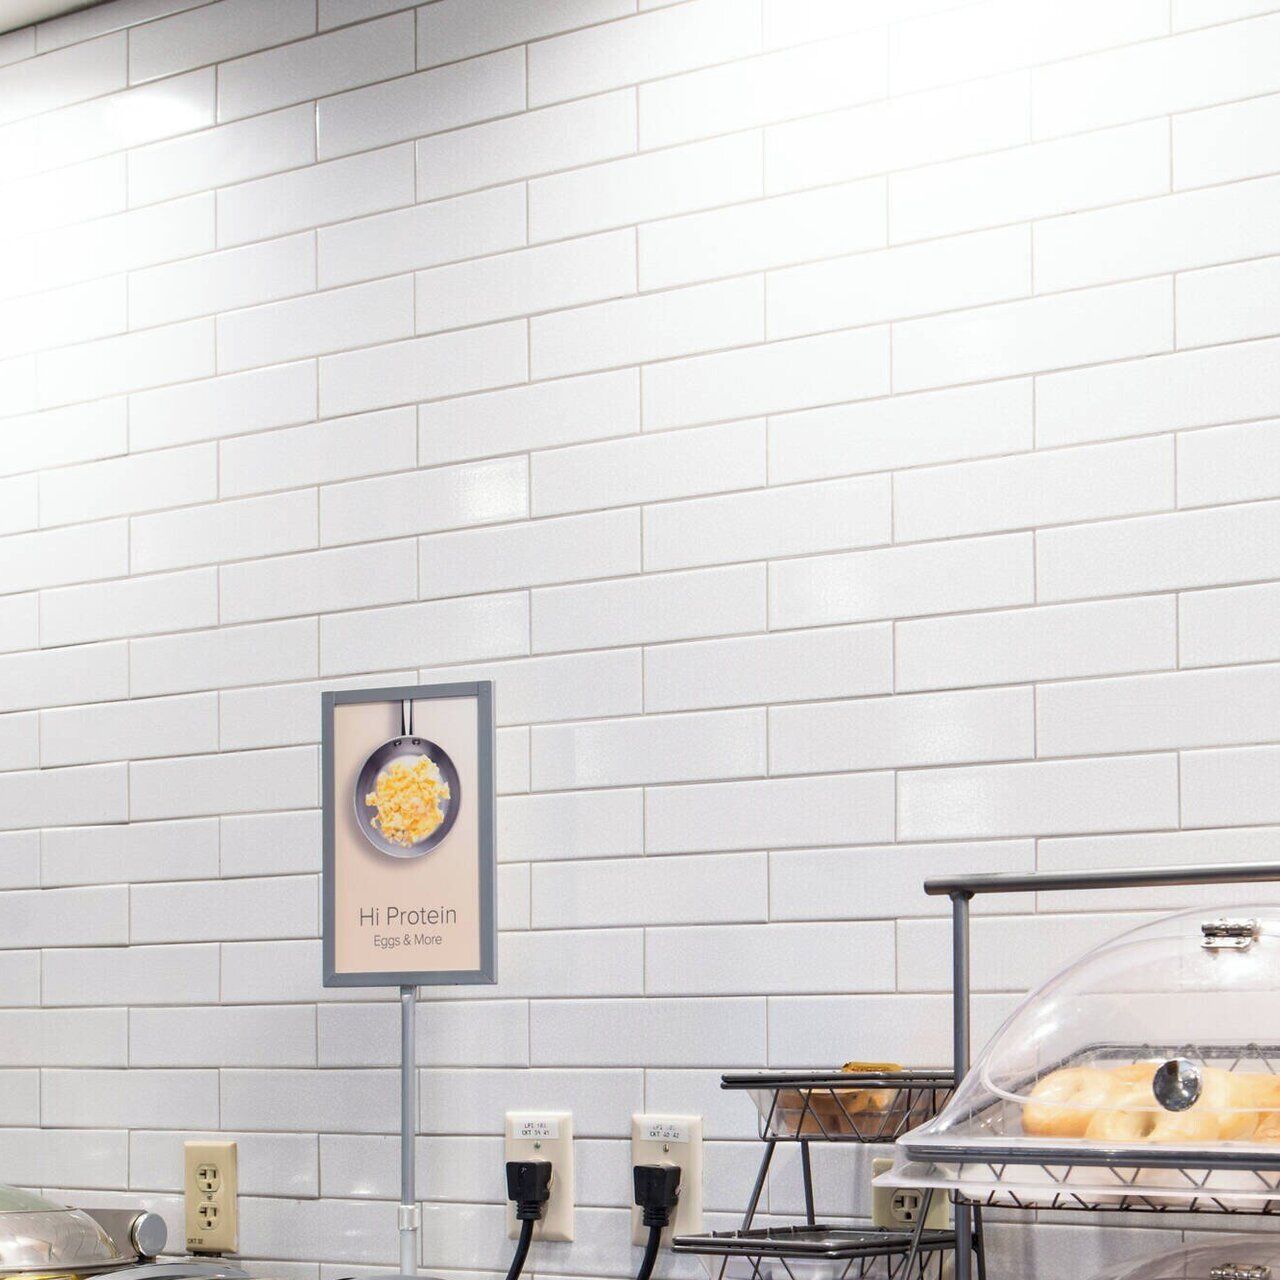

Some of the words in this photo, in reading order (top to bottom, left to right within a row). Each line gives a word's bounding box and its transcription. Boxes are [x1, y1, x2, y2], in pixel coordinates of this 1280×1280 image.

[360, 906, 379, 926] Hi
[387, 905, 457, 925] Protein
[374, 934, 400, 949] Eggs
[403, 933, 411, 945] &
[414, 933, 442, 945] More
